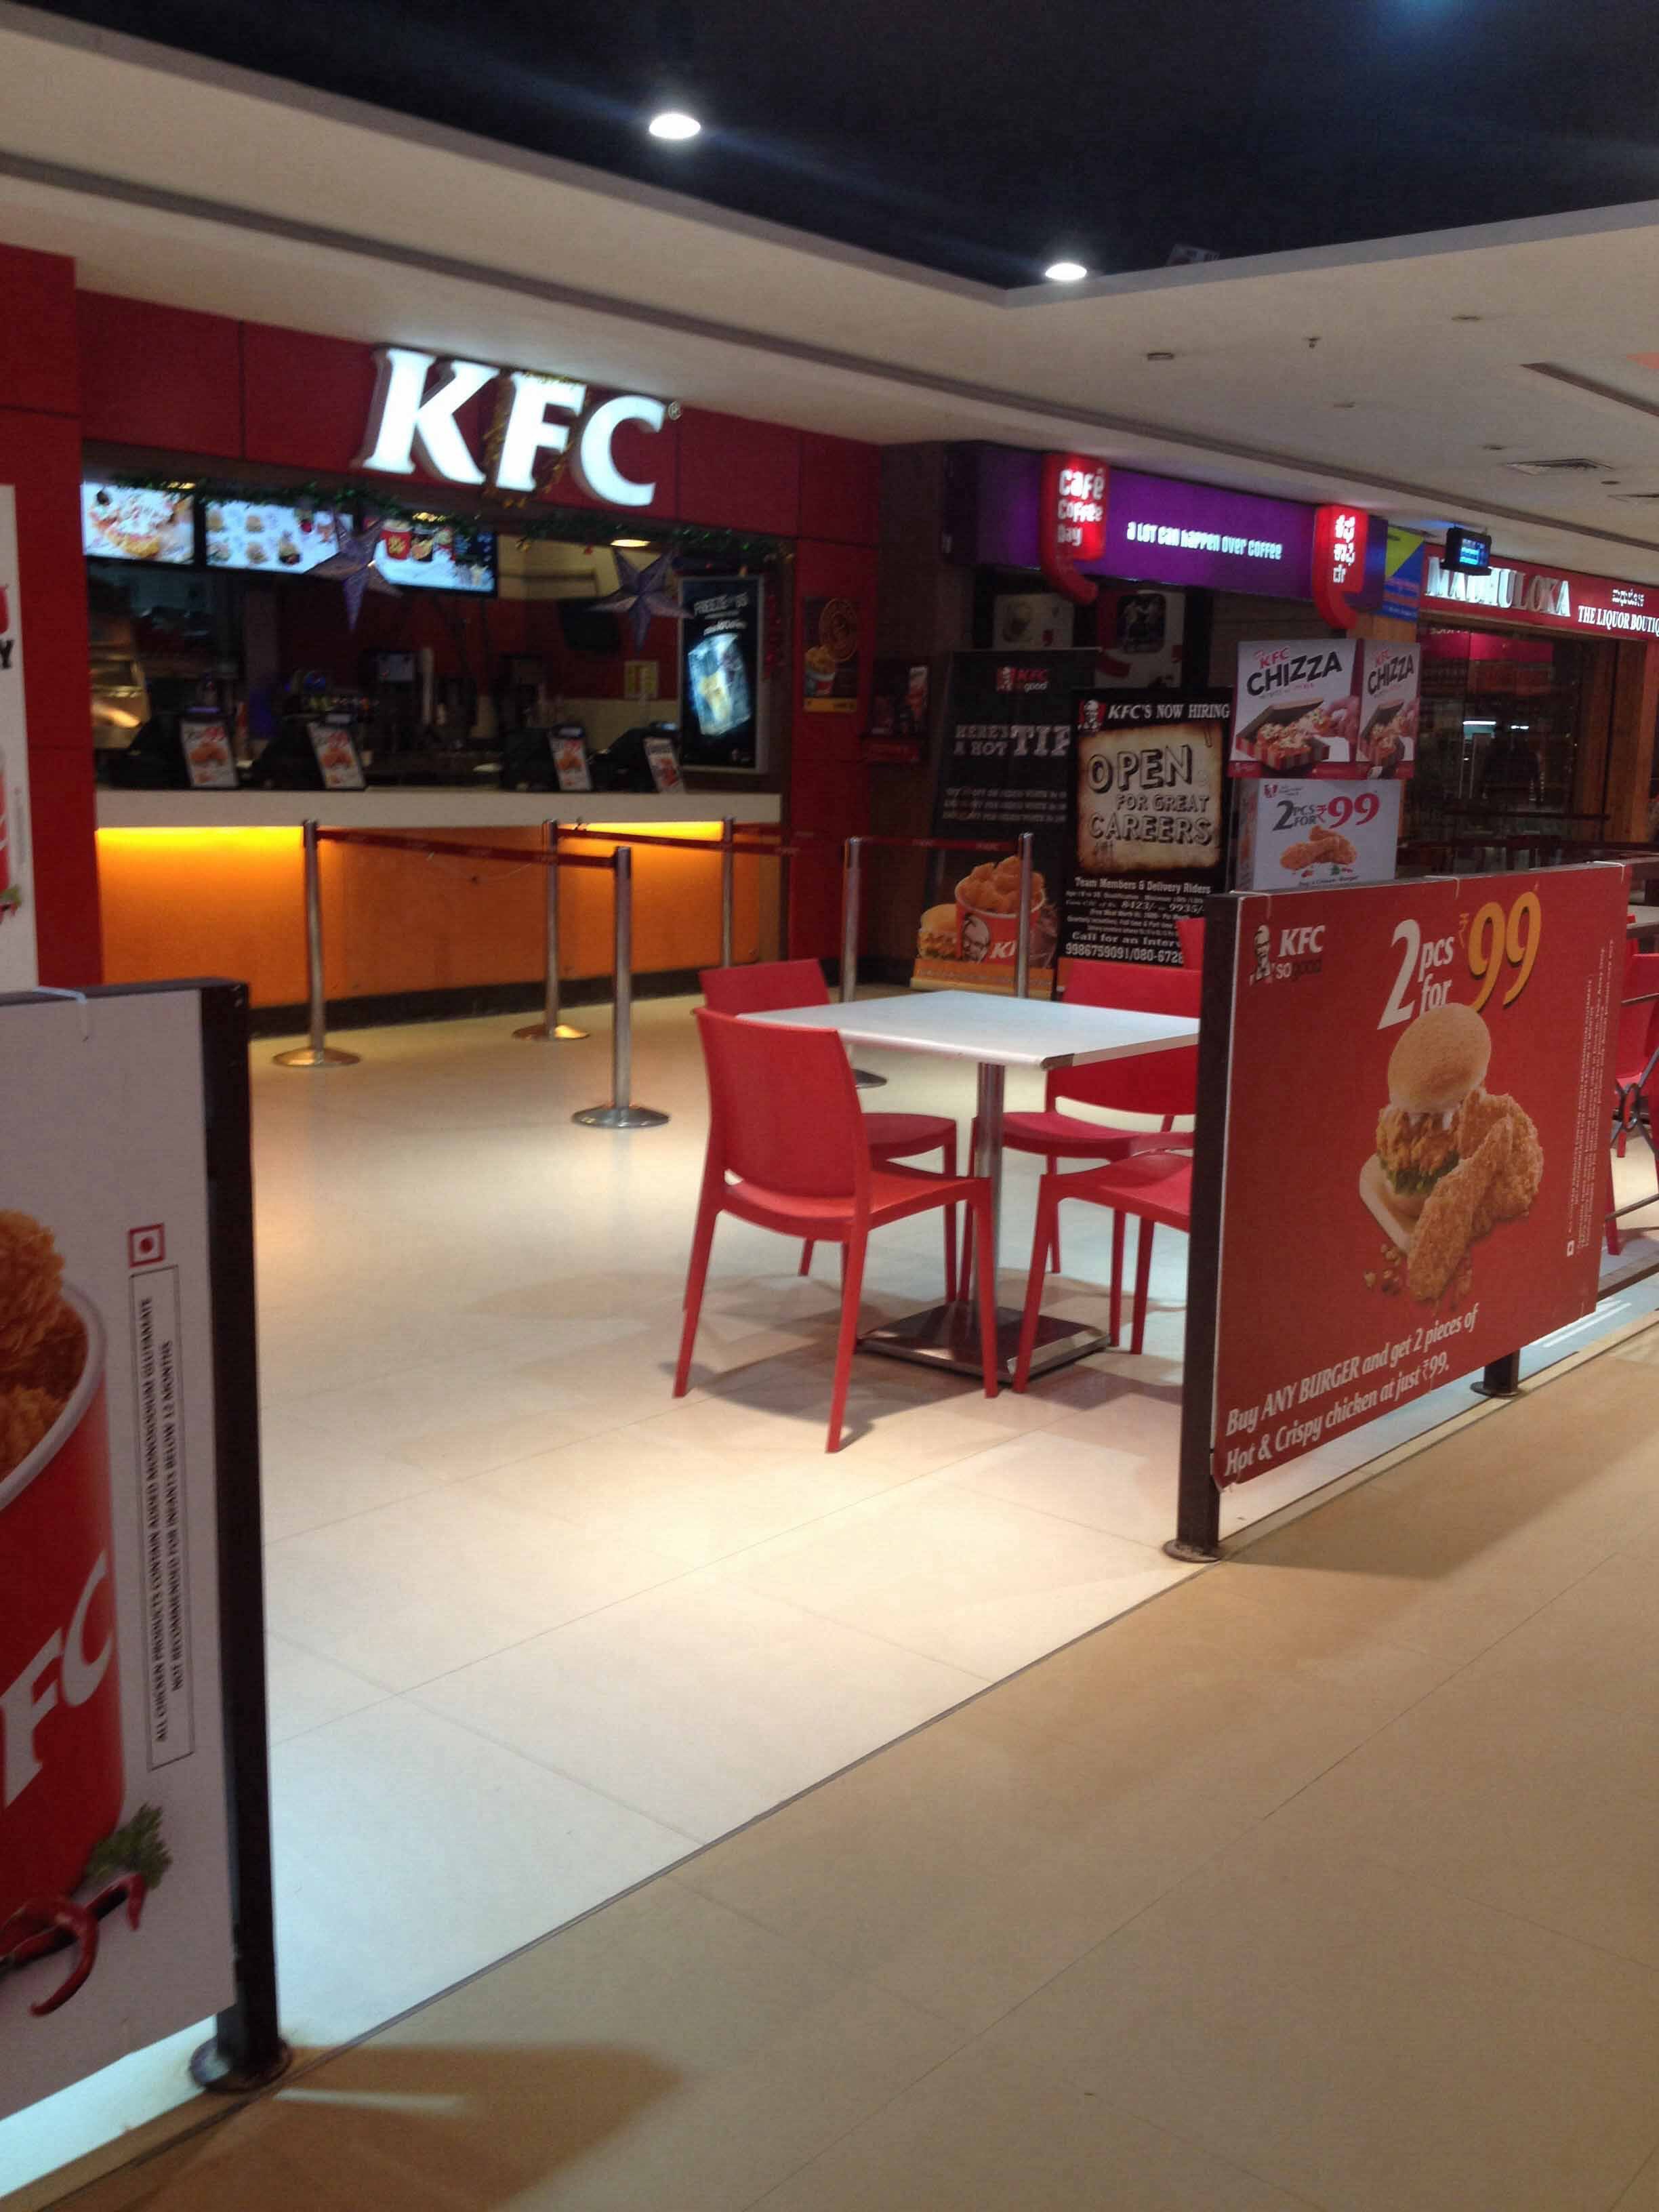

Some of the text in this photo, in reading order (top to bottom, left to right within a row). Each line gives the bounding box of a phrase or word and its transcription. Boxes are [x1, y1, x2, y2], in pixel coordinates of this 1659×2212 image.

[361, 347, 667, 507] KFC
[1578, 605, 1596, 624] THE
[1596, 609, 1630, 630] LIQUOR
[1246, 651, 1343, 696] CHIZZA
[1259, 646, 1290, 668] KFC
[1368, 654, 1414, 695] CHIZZA
[1107, 703, 1231, 720] KFC'S NOW HIRING
[1087, 743, 1193, 794] OPEN
[1117, 794, 1210, 813] FOR GREAT
[1271, 800, 1294, 831] 2
[1088, 812, 1212, 846] CAREERS
[1073, 876, 1097, 888] Team
[1099, 878, 1136, 890] Members
[1147, 880, 1181, 894] Delivery
[1183, 882, 1211, 895] Riders
[1100, 933, 1118, 943] for
[1277, 924, 1326, 957] KFC
[1377, 919, 1420, 1030] 2
[1418, 936, 1455, 983] pcs
[1419, 973, 1452, 1018] for
[1225, 1302, 1480, 1437] Buy ANY BURGER and get 2 pieces of
[1224, 1443, 1255, 1476] Hot
[1258, 1435, 1273, 1460] &
[1275, 1415, 1324, 1452] Crispy
[1324, 1389, 1378, 1429] chicken
[1378, 1380, 1395, 1403] at
[1394, 1365, 1422, 1402] just
